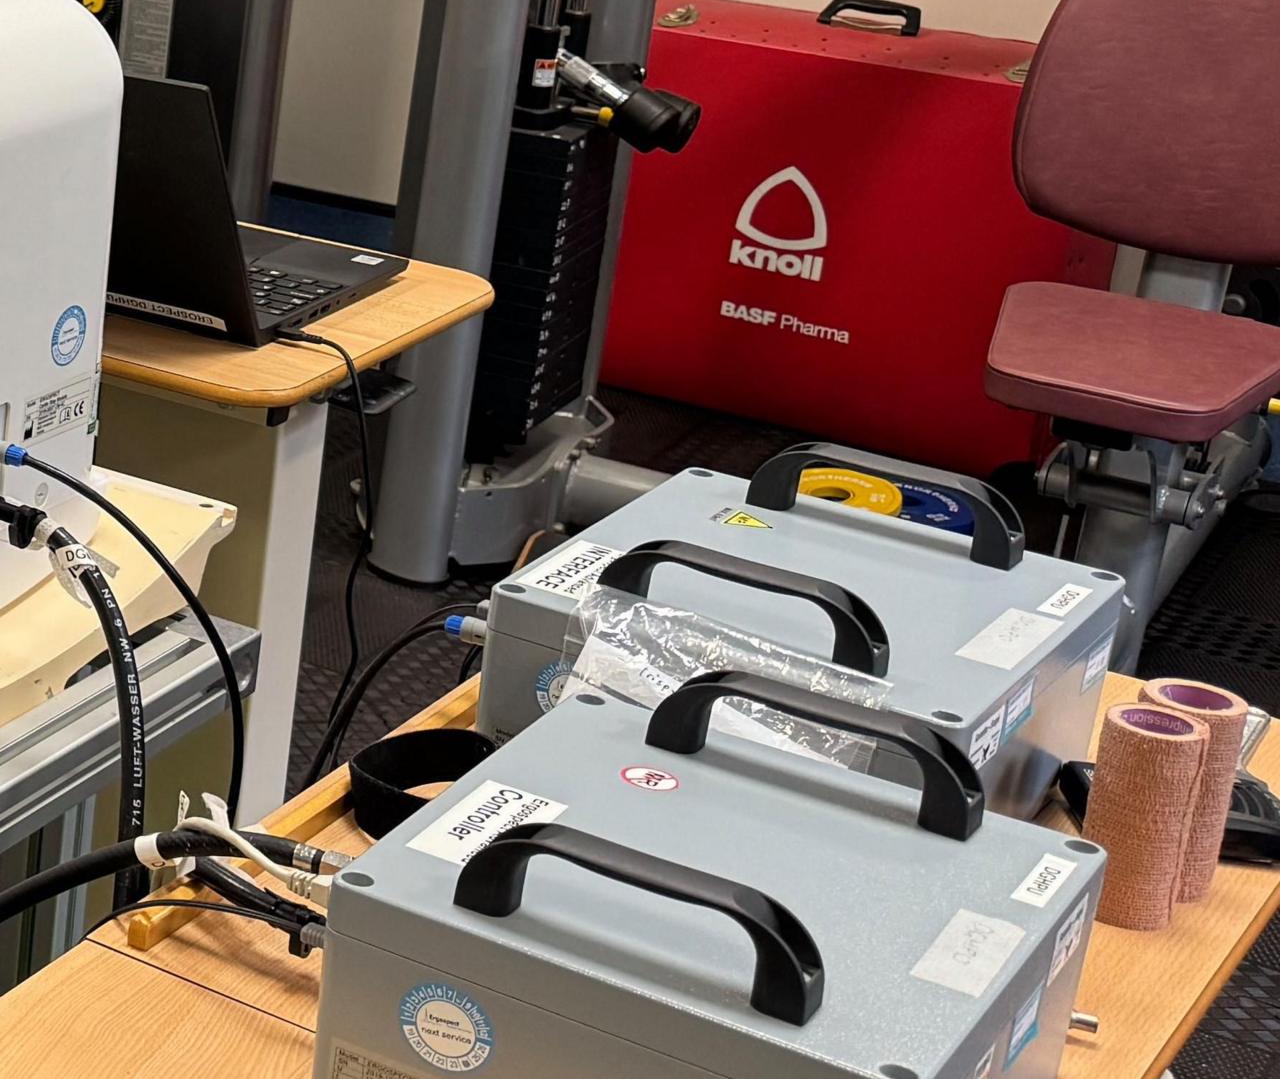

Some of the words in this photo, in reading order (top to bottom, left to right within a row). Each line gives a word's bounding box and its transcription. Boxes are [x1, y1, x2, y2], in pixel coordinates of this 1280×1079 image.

[728, 238, 824, 281] knoll
[720, 300, 777, 326] BASF
[780, 314, 850, 344] Pharma
[535, 545, 613, 589] INTERFACE
[101, 588, 116, 609] PN
[120, 637, 133, 663] NW
[128, 673, 144, 788] LUFT-WASSER
[447, 789, 523, 840] Controller
[1026, 866, 1061, 897] DGHPU
[421, 1027, 439, 1036] next
[441, 1031, 472, 1045] service
